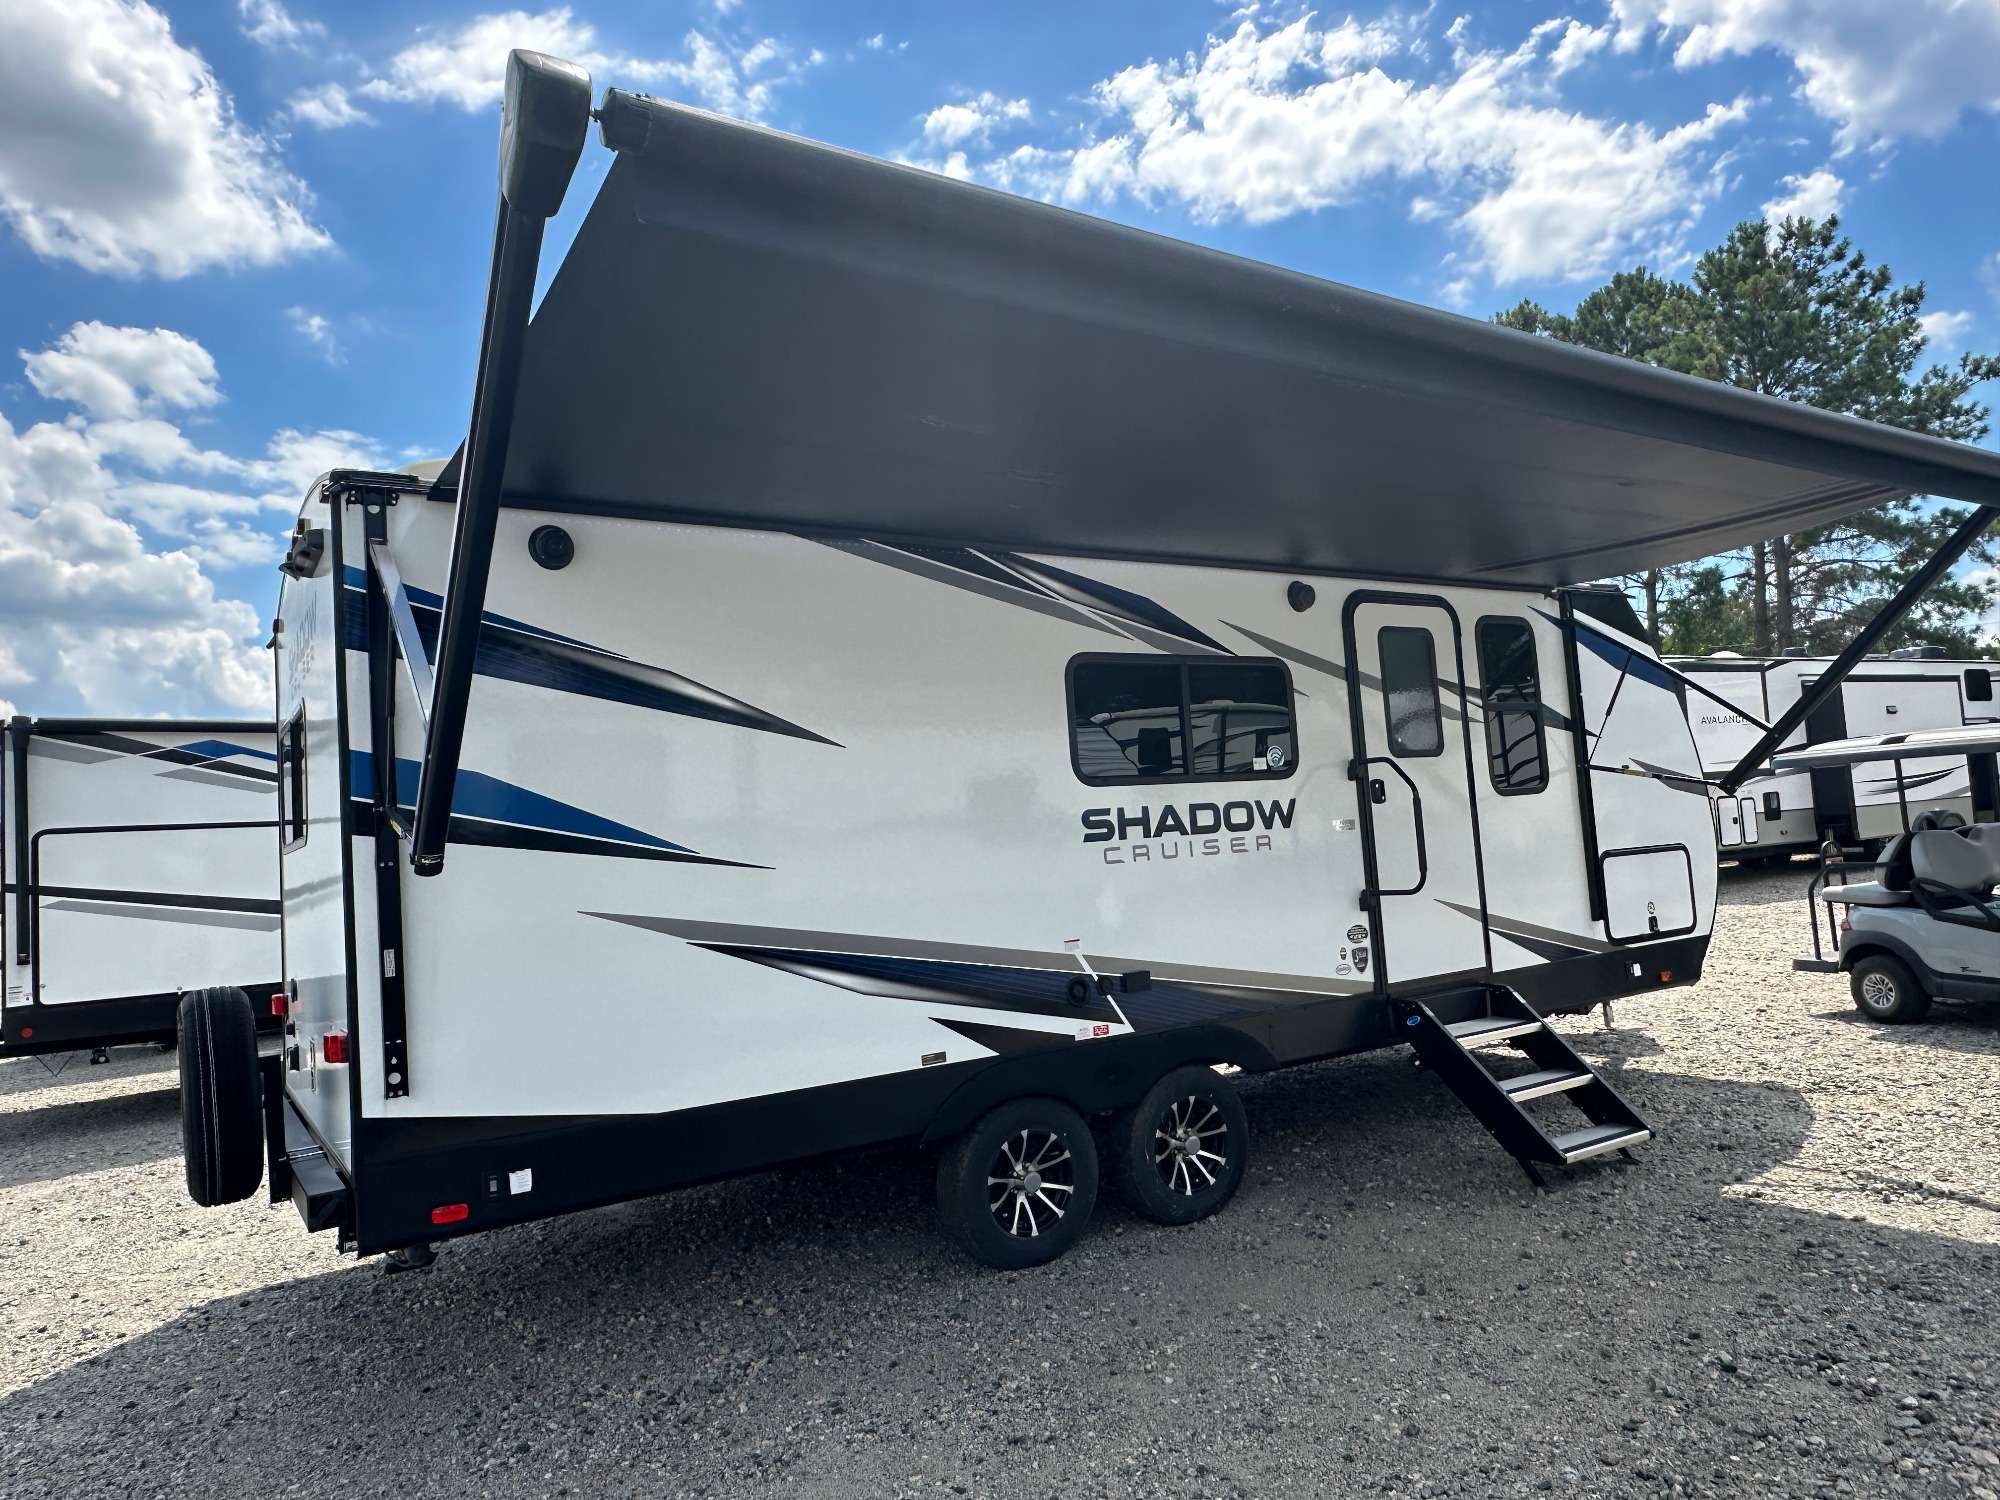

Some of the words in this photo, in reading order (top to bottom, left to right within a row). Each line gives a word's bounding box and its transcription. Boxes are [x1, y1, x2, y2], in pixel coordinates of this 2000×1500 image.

[1701, 715, 1749, 725] AVALANC
[1081, 797, 1297, 843] SHADOW
[1103, 834, 1273, 865] CRUISER
